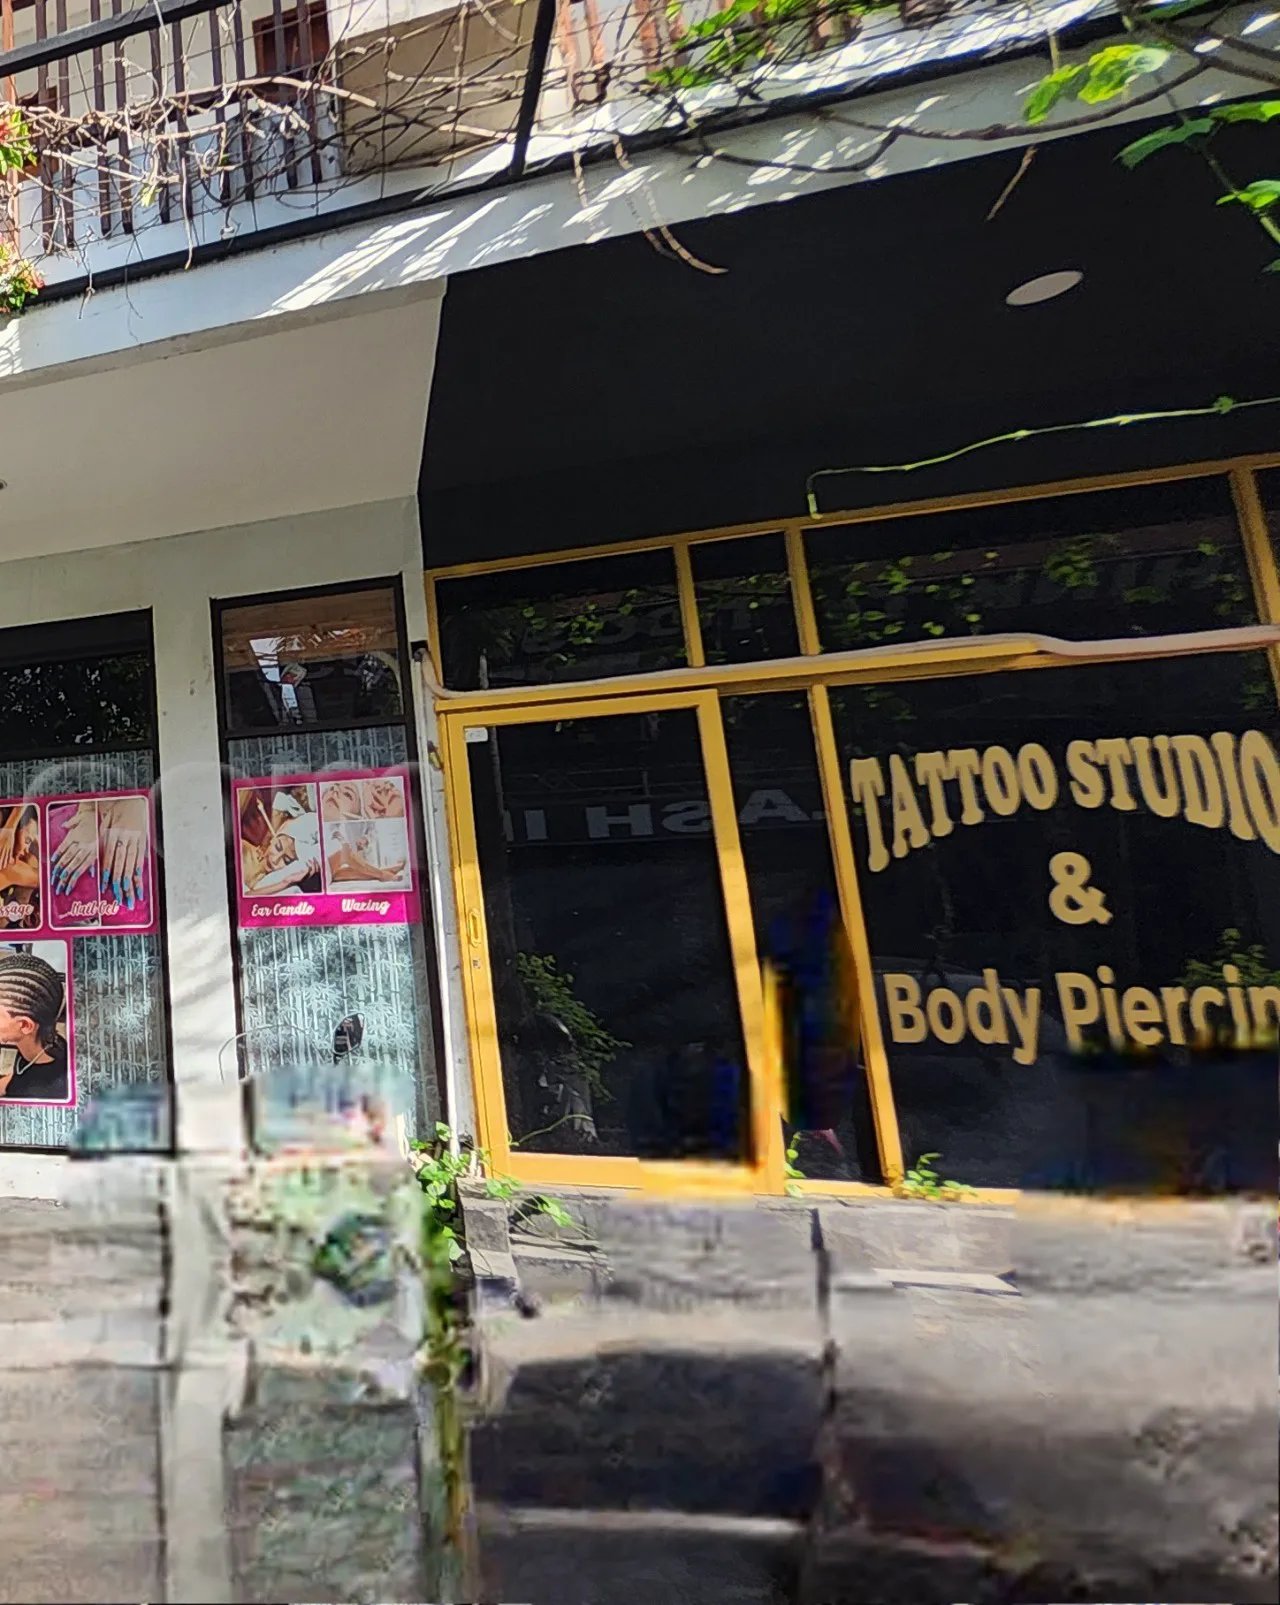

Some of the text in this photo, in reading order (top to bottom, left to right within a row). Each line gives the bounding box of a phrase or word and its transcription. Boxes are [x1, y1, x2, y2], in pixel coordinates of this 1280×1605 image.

[850, 729, 1280, 872] TATTOO STUDIO
[70, 901, 98, 917] Nail
[252, 902, 315, 917] Ear Candle
[341, 898, 391, 915] Waxing
[1049, 851, 1113, 925] &
[884, 967, 1041, 1065] Body
